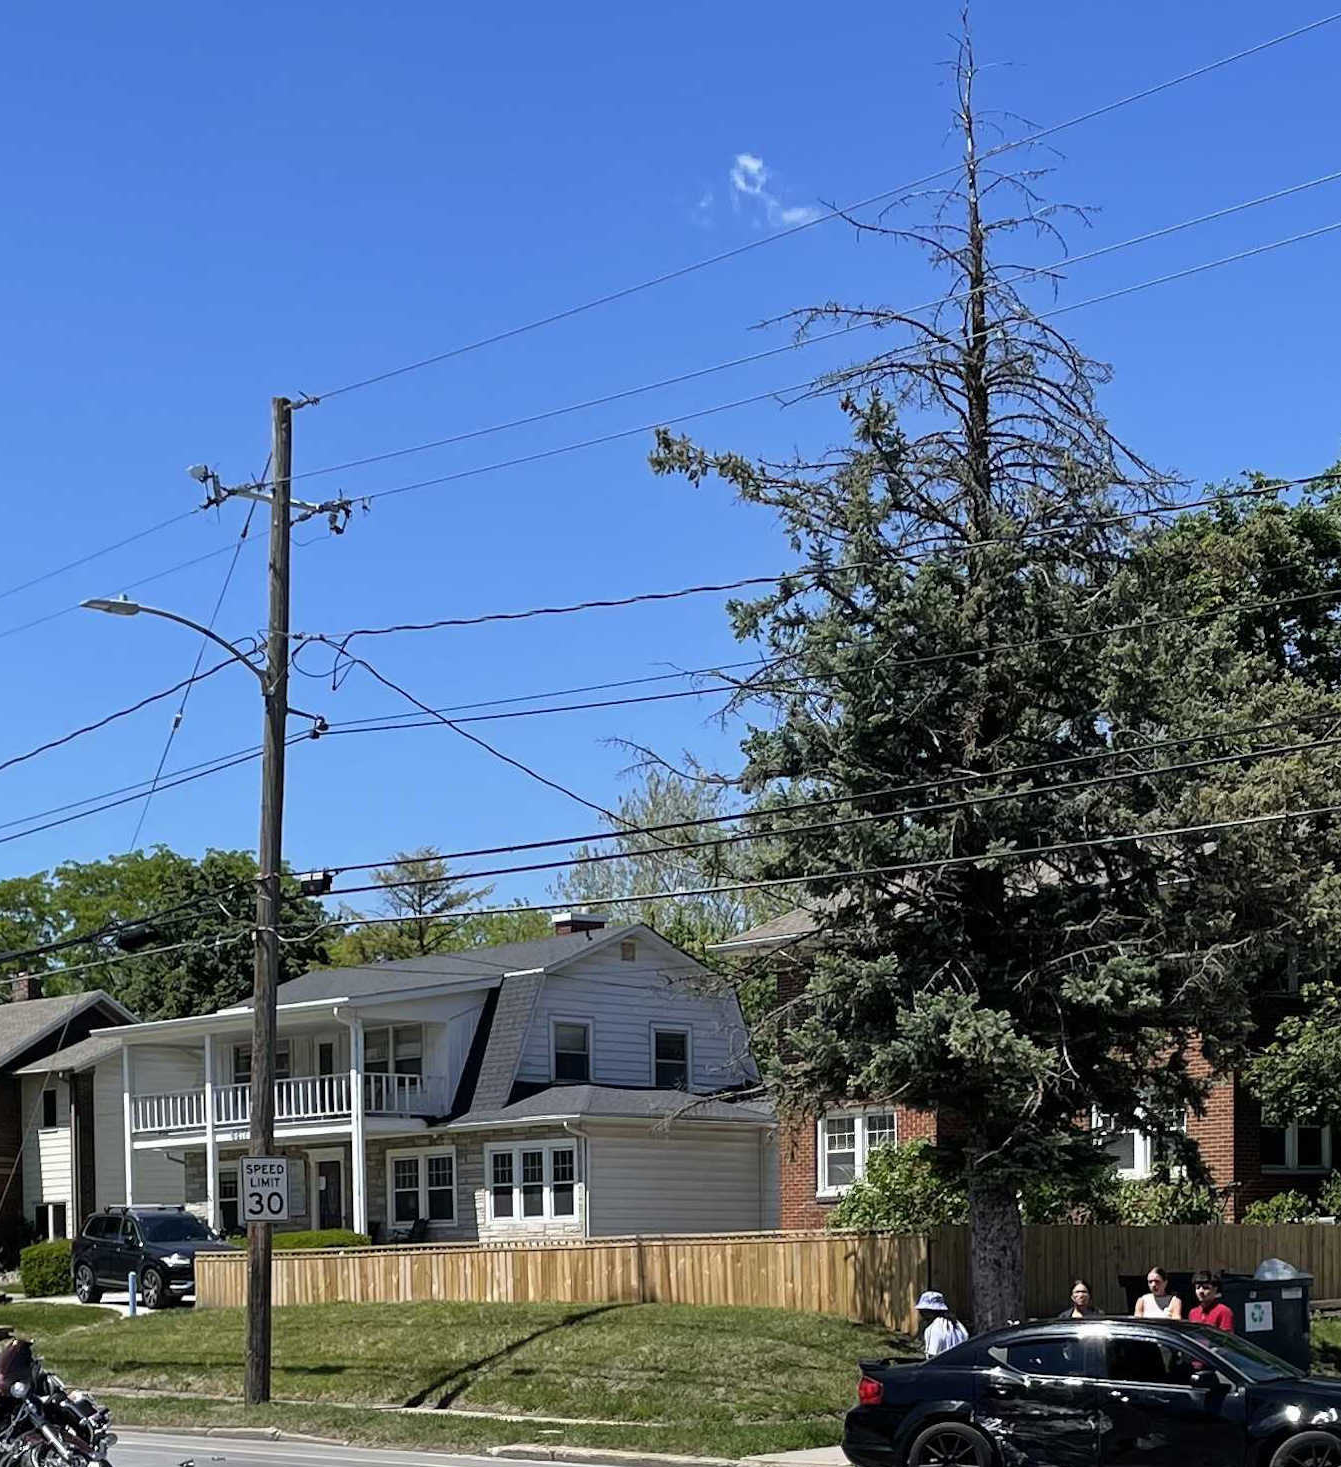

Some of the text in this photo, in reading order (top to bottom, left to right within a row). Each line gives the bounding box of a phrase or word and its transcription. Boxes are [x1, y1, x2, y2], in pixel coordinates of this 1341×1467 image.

[246, 1164, 285, 1175] SPEED
[250, 1177, 281, 1188] LIMIT
[248, 1191, 284, 1215] 30
